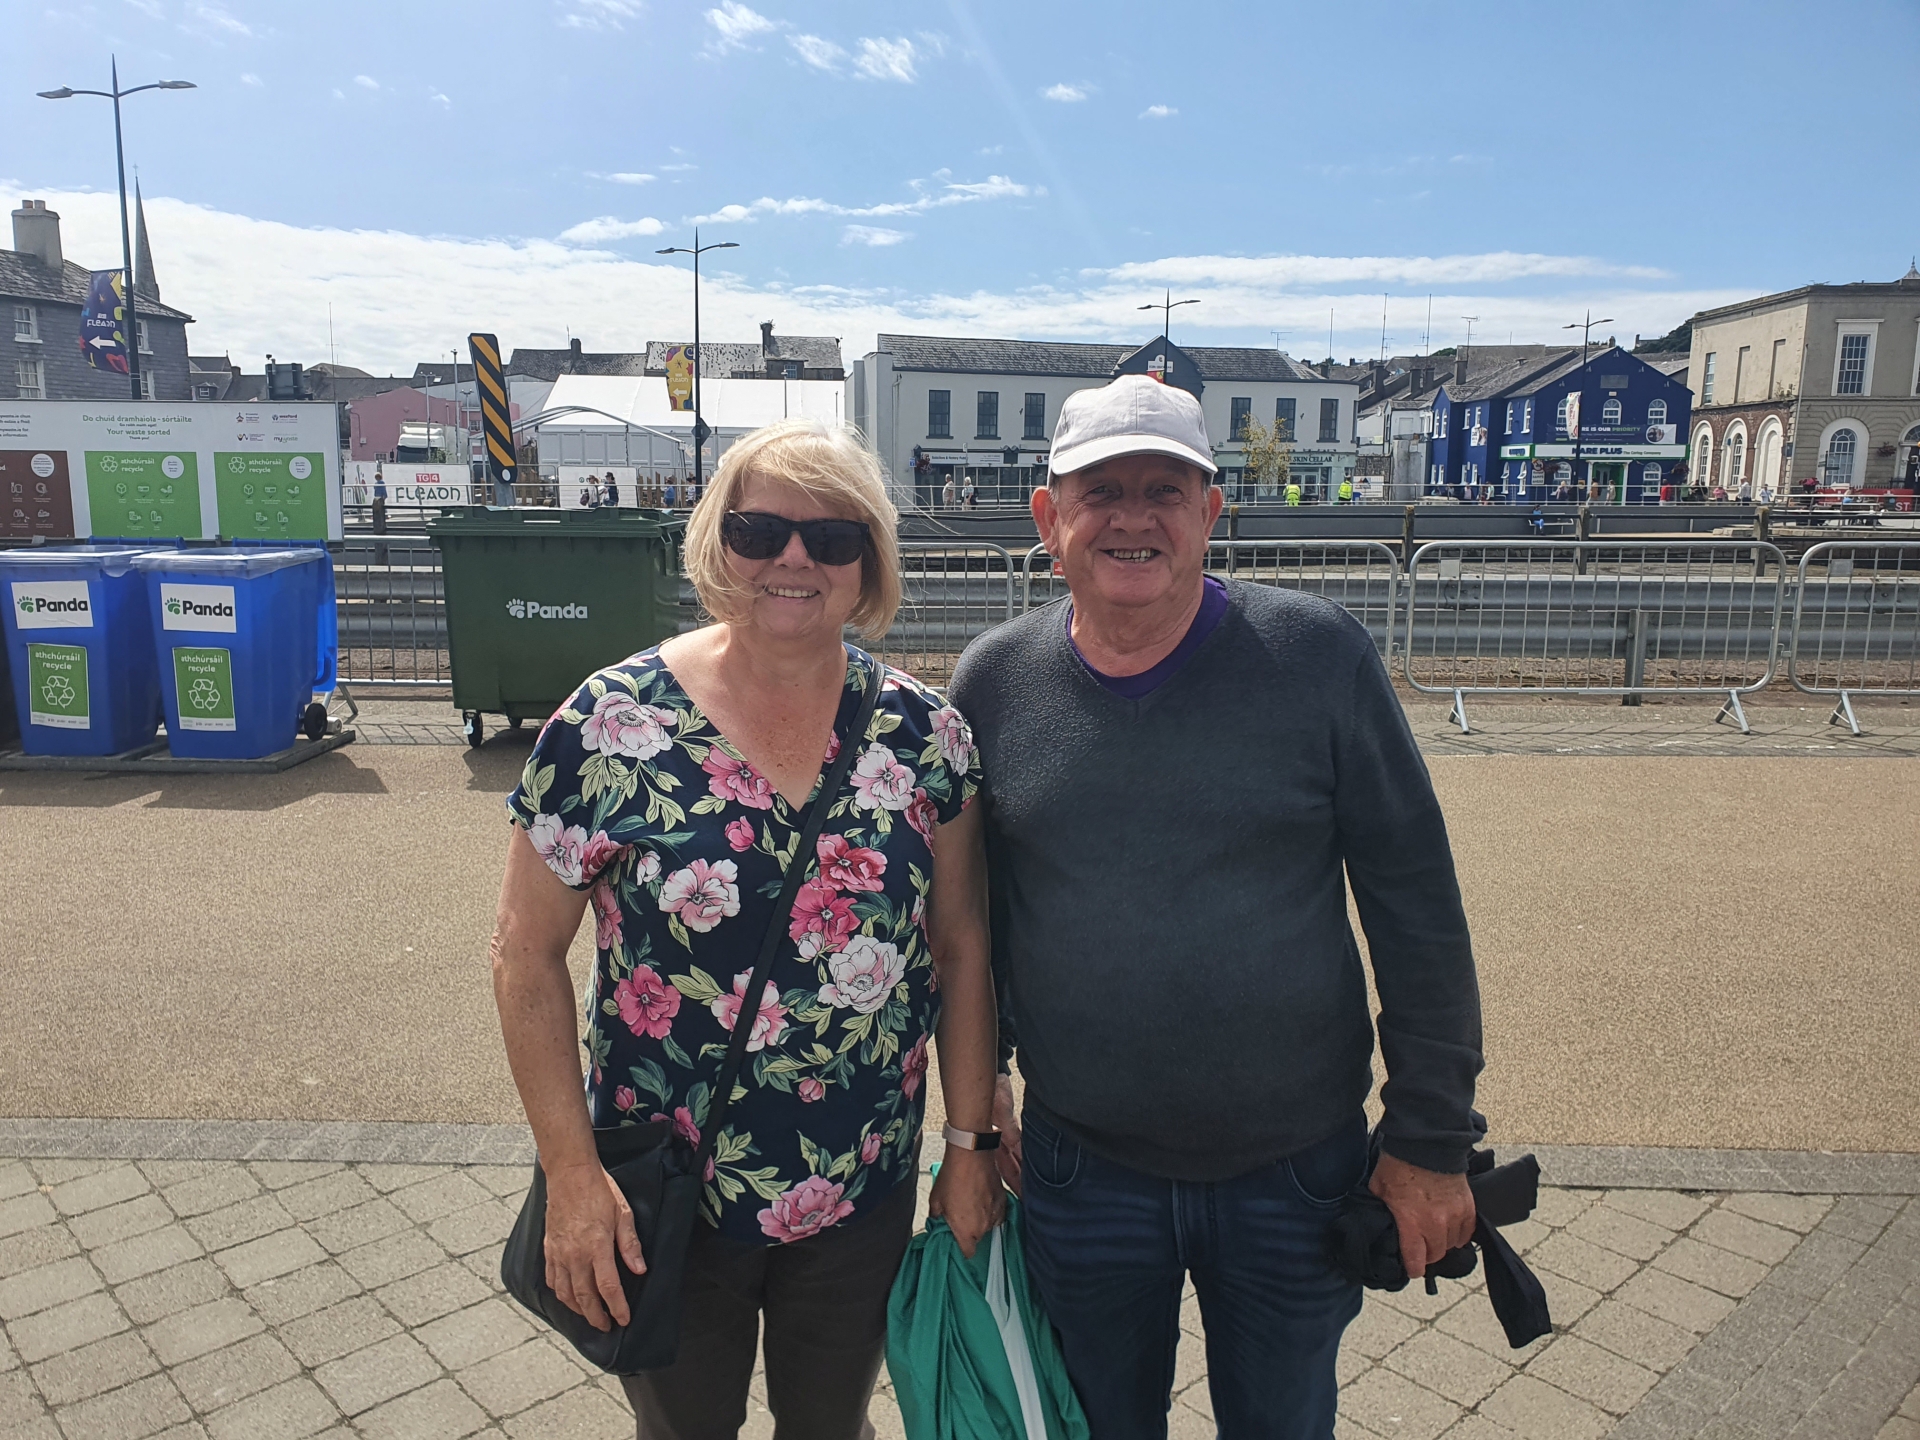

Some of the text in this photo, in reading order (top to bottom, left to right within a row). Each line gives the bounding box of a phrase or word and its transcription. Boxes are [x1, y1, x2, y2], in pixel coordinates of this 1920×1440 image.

[82, 414, 94, 422] Do
[95, 414, 115, 422] chuid
[162, 415, 192, 423] sórtáilte
[1599, 447, 1623, 455] PLUS
[1308, 455, 1333, 463] CELLAR
[35, 597, 89, 613] Panda
[182, 600, 234, 617] Panda
[526, 601, 588, 619] Panda
[35, 651, 81, 662] athchúrsáil
[180, 654, 223, 664] athchúrsáil
[42, 661, 72, 671] recycle
[188, 664, 216, 674] recycle
